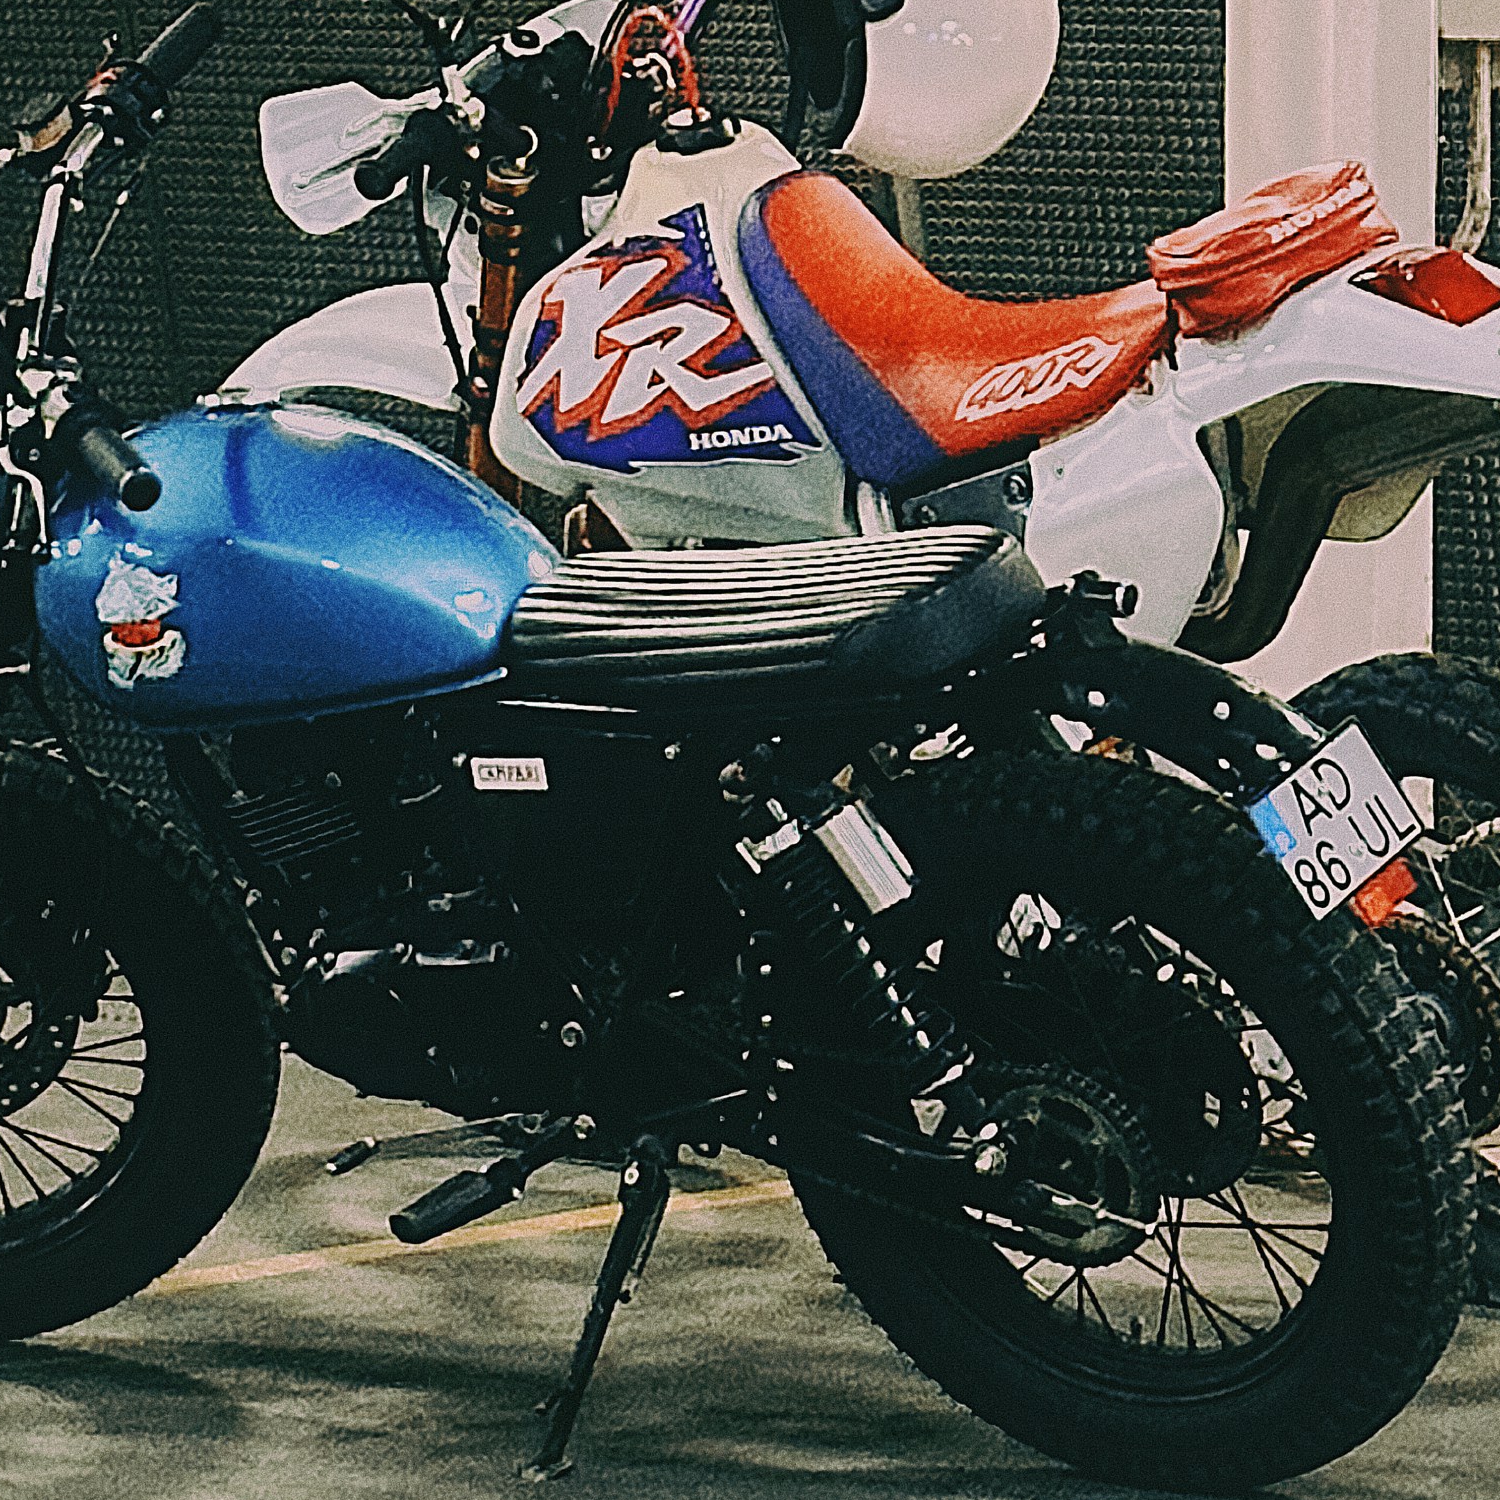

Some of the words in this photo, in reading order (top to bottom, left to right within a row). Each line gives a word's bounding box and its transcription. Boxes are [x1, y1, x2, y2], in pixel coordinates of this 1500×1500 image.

[515, 256, 775, 424] XR
[688, 423, 794, 451] HONDA
[1290, 757, 1351, 837] AD
[1294, 840, 1352, 909] 86
[1347, 793, 1418, 858] UL
